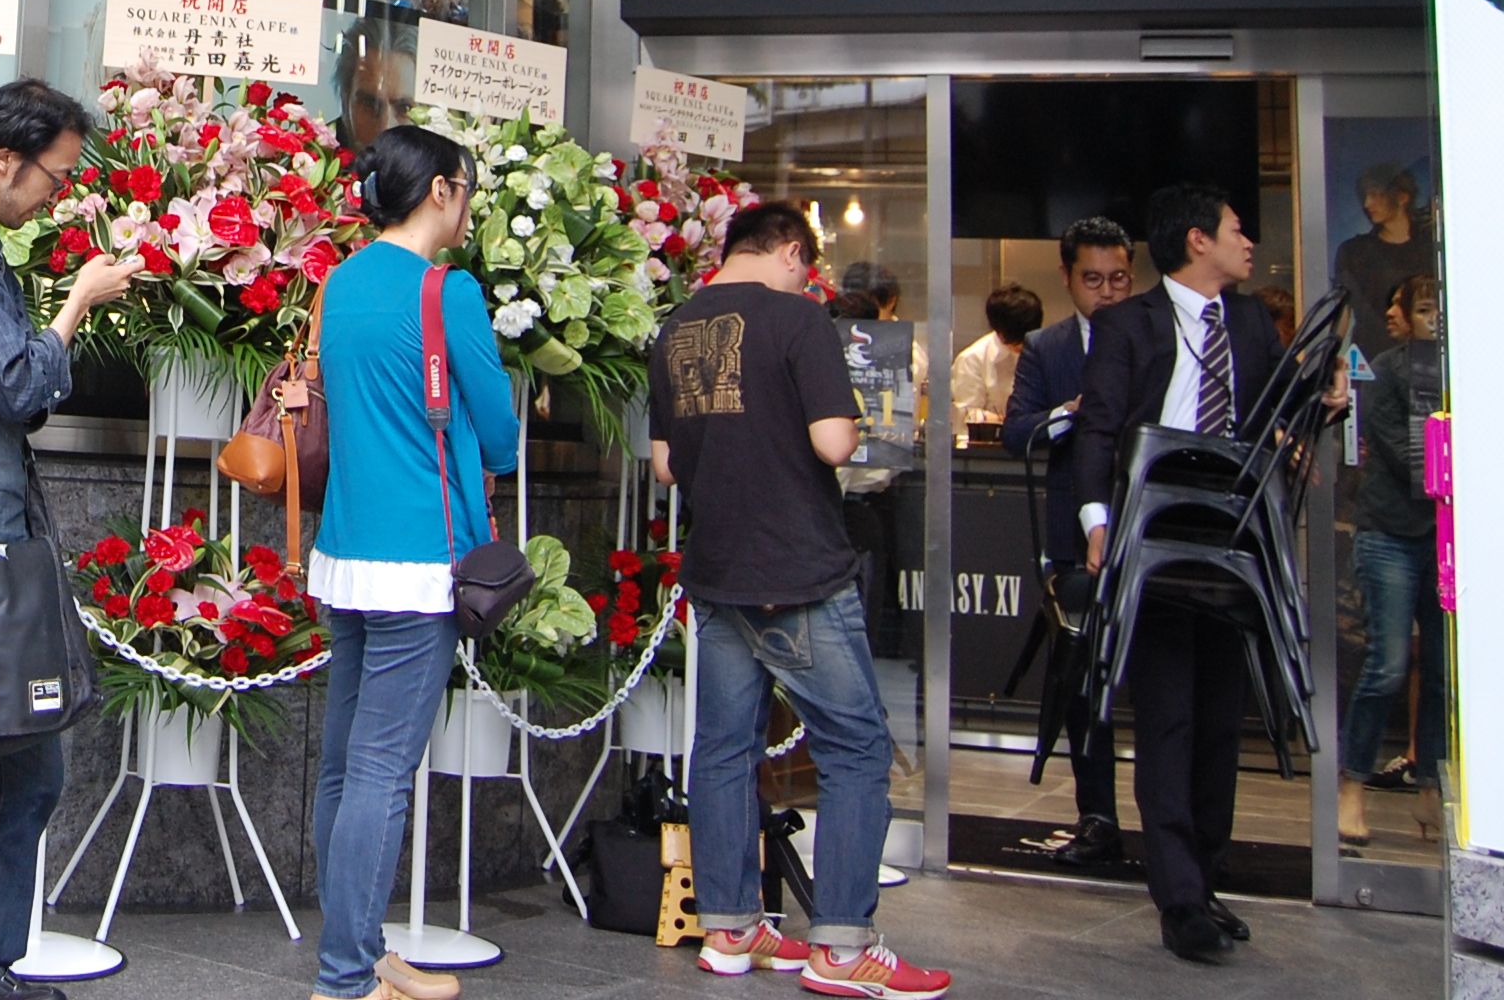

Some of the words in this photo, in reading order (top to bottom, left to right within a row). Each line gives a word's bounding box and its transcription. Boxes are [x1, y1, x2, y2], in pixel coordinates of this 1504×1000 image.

[126, 7, 192, 25] SQUARE
[199, 14, 238, 30] ENIX
[468, 33, 517, 60] 祝開店
[434, 47, 477, 66] SQUARE
[481, 57, 508, 73] ENIX
[645, 89, 679, 106] SQUARE
[429, 354, 441, 398] Canon
[994, 575, 1021, 617] XV
